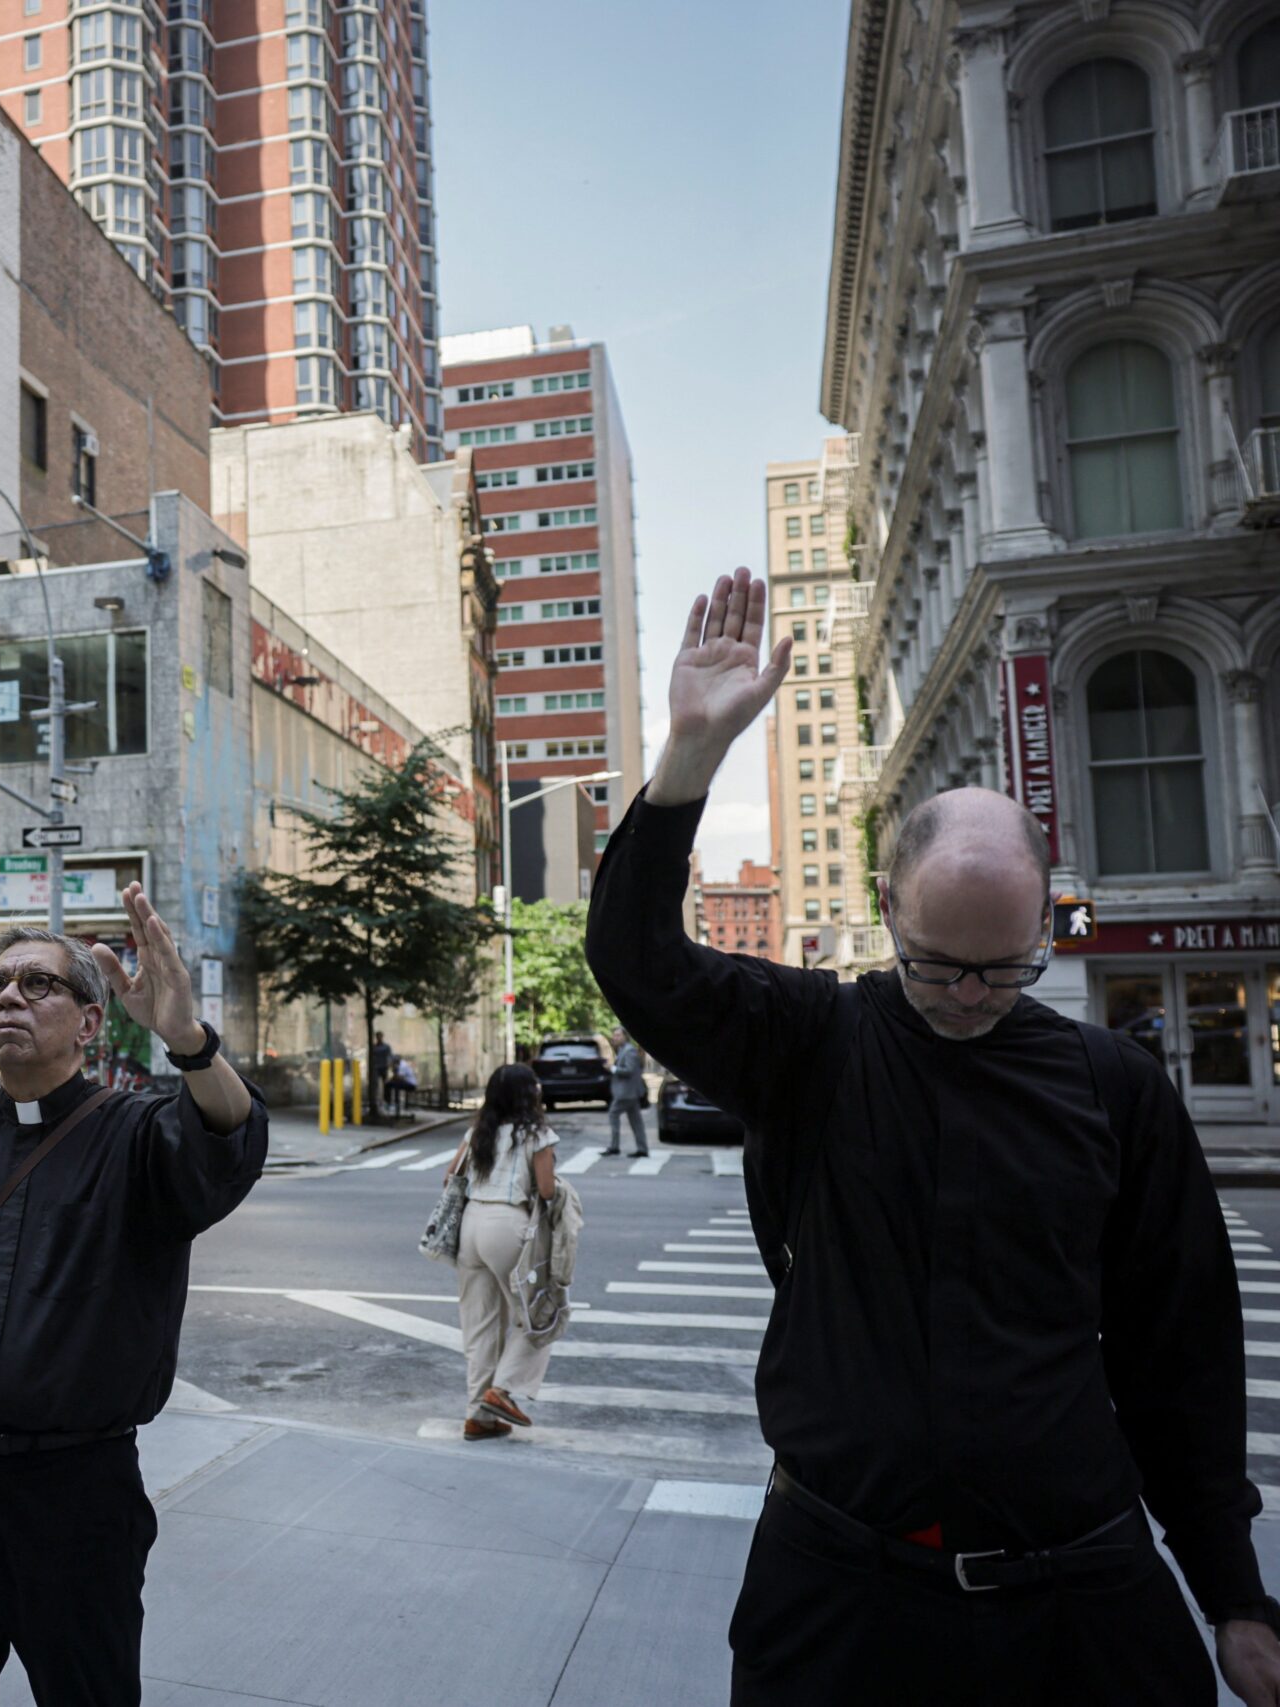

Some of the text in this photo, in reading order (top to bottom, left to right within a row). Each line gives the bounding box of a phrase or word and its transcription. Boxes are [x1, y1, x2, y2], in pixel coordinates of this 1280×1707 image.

[1022, 703, 1054, 814] PRET A MANGER
[34, 832, 76, 841] ONE WAY
[5, 858, 42, 871] Broadway
[1173, 925, 1216, 949] PRET
[1222, 925, 1234, 948] A
